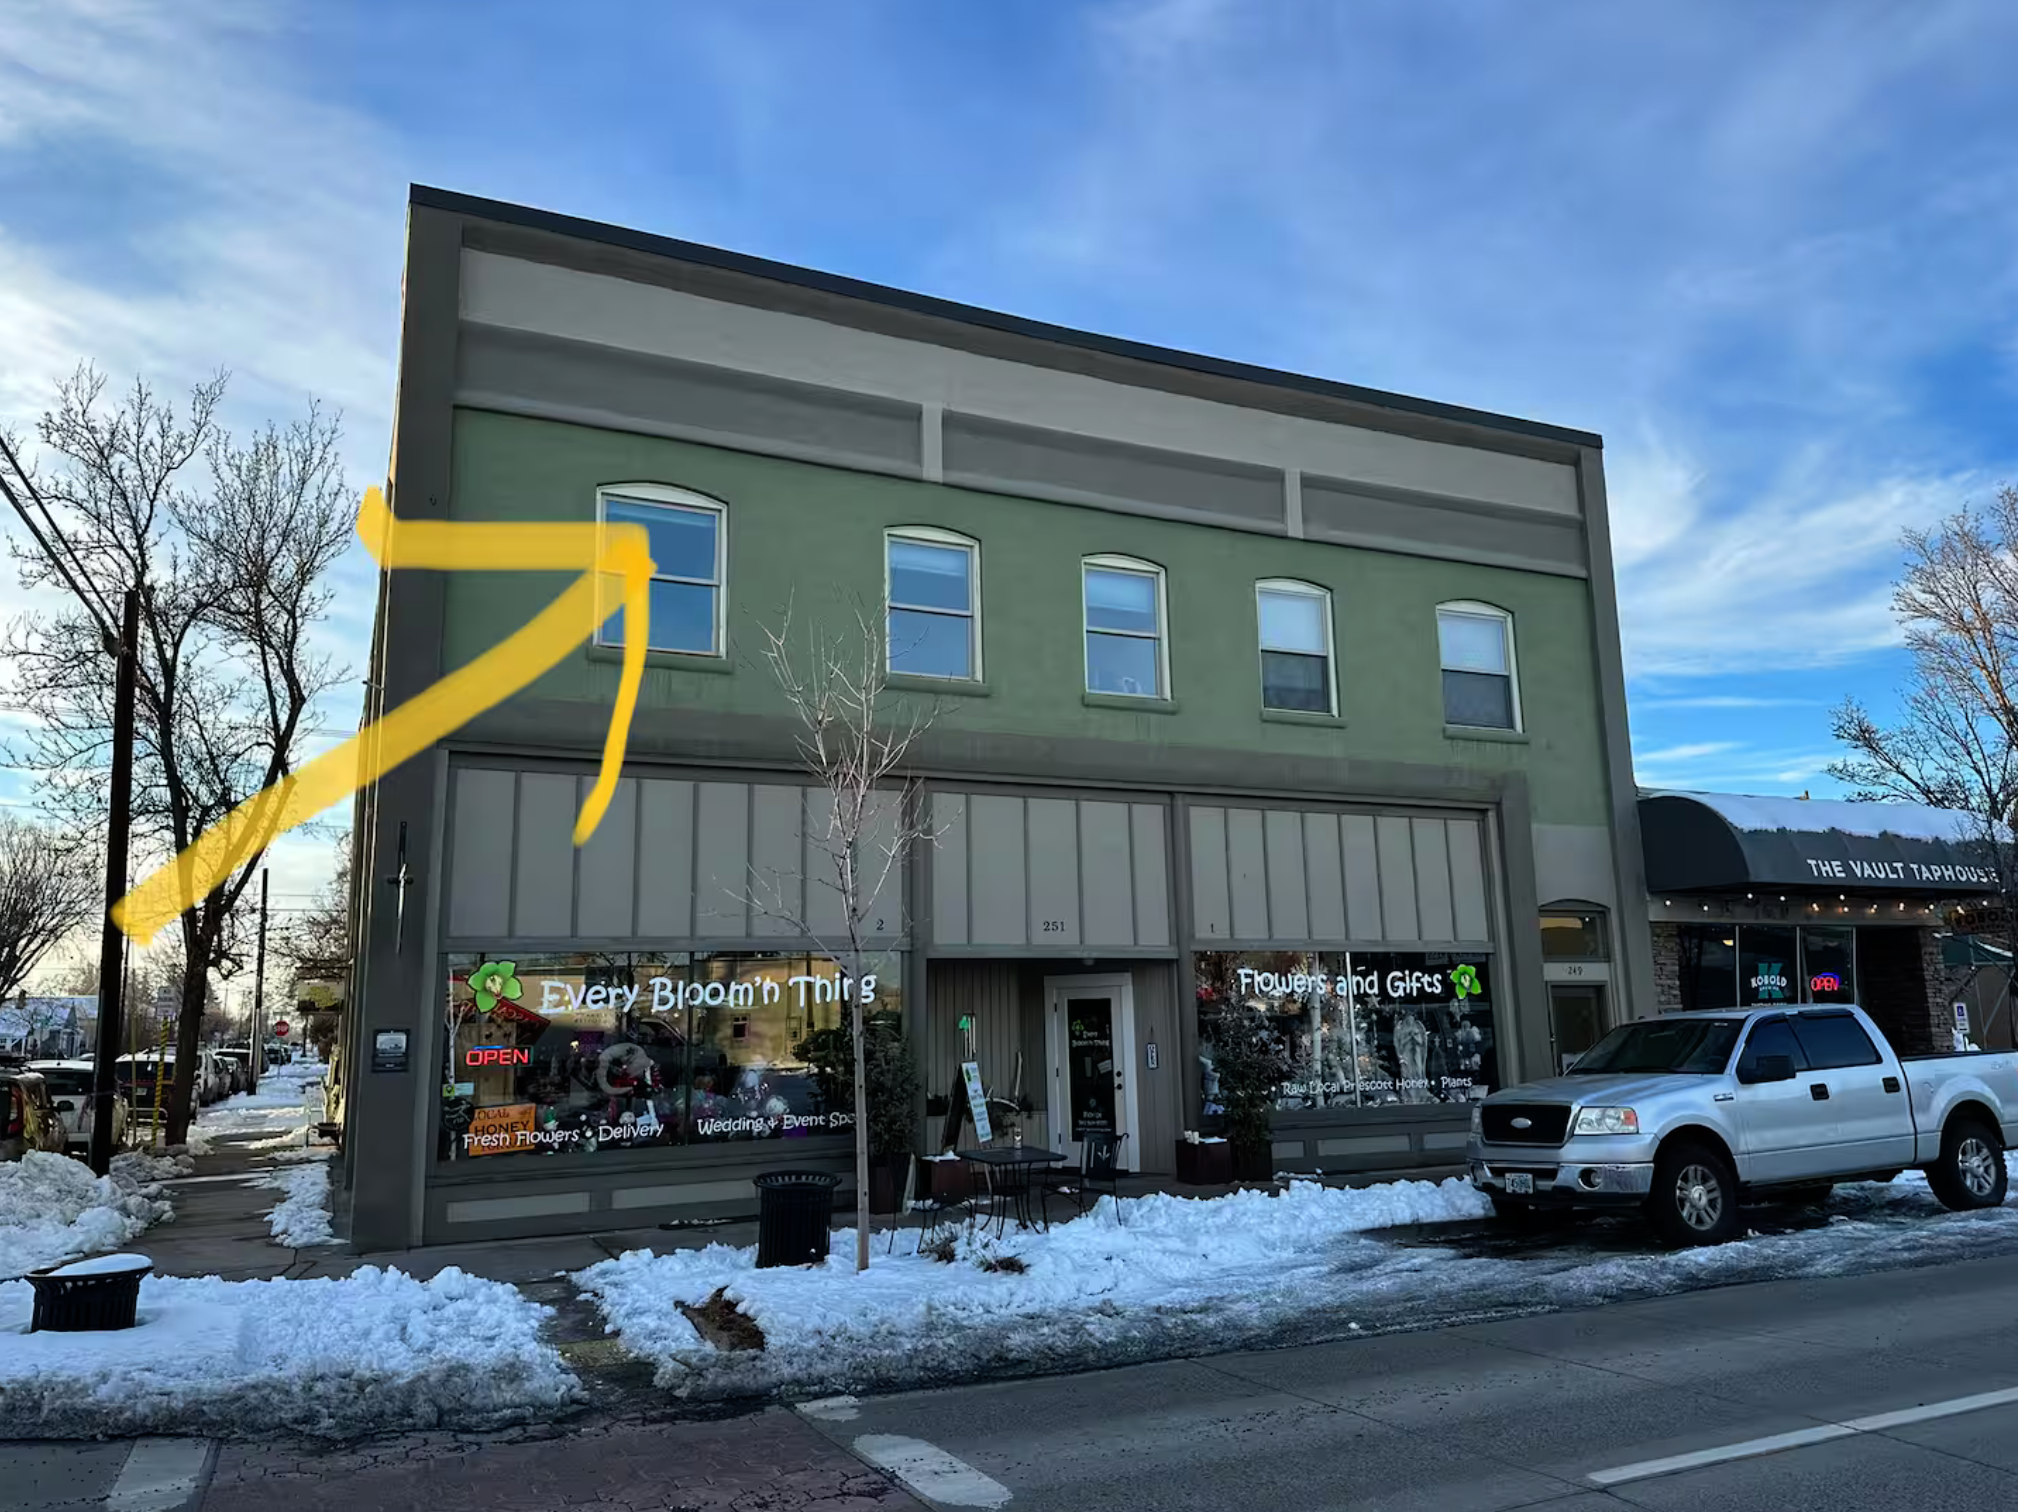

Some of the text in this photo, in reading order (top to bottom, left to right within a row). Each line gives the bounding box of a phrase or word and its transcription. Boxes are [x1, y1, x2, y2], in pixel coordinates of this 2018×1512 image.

[1806, 858, 1846, 878] THE
[1849, 860, 1904, 879] VAULT
[876, 919, 884, 931] 2
[1043, 920, 1066, 932] 251
[1237, 968, 1442, 998] Flowers and Gifts
[1750, 975, 1787, 988] KOBOLD
[1811, 977, 1840, 991] OPEN
[539, 973, 877, 1014] Every Bloom'n Thing
[466, 1048, 529, 1066] OPEN
[1281, 1076, 1472, 1095] Raw Local Prescott Honey Plants
[474, 1121, 530, 1138] HONEY
[697, 1116, 764, 1135] Wedding
[782, 1113, 826, 1129] Event
[462, 1132, 510, 1150] Fresh
[515, 1128, 580, 1146] Flowers
[598, 1122, 664, 1142] Delivery
